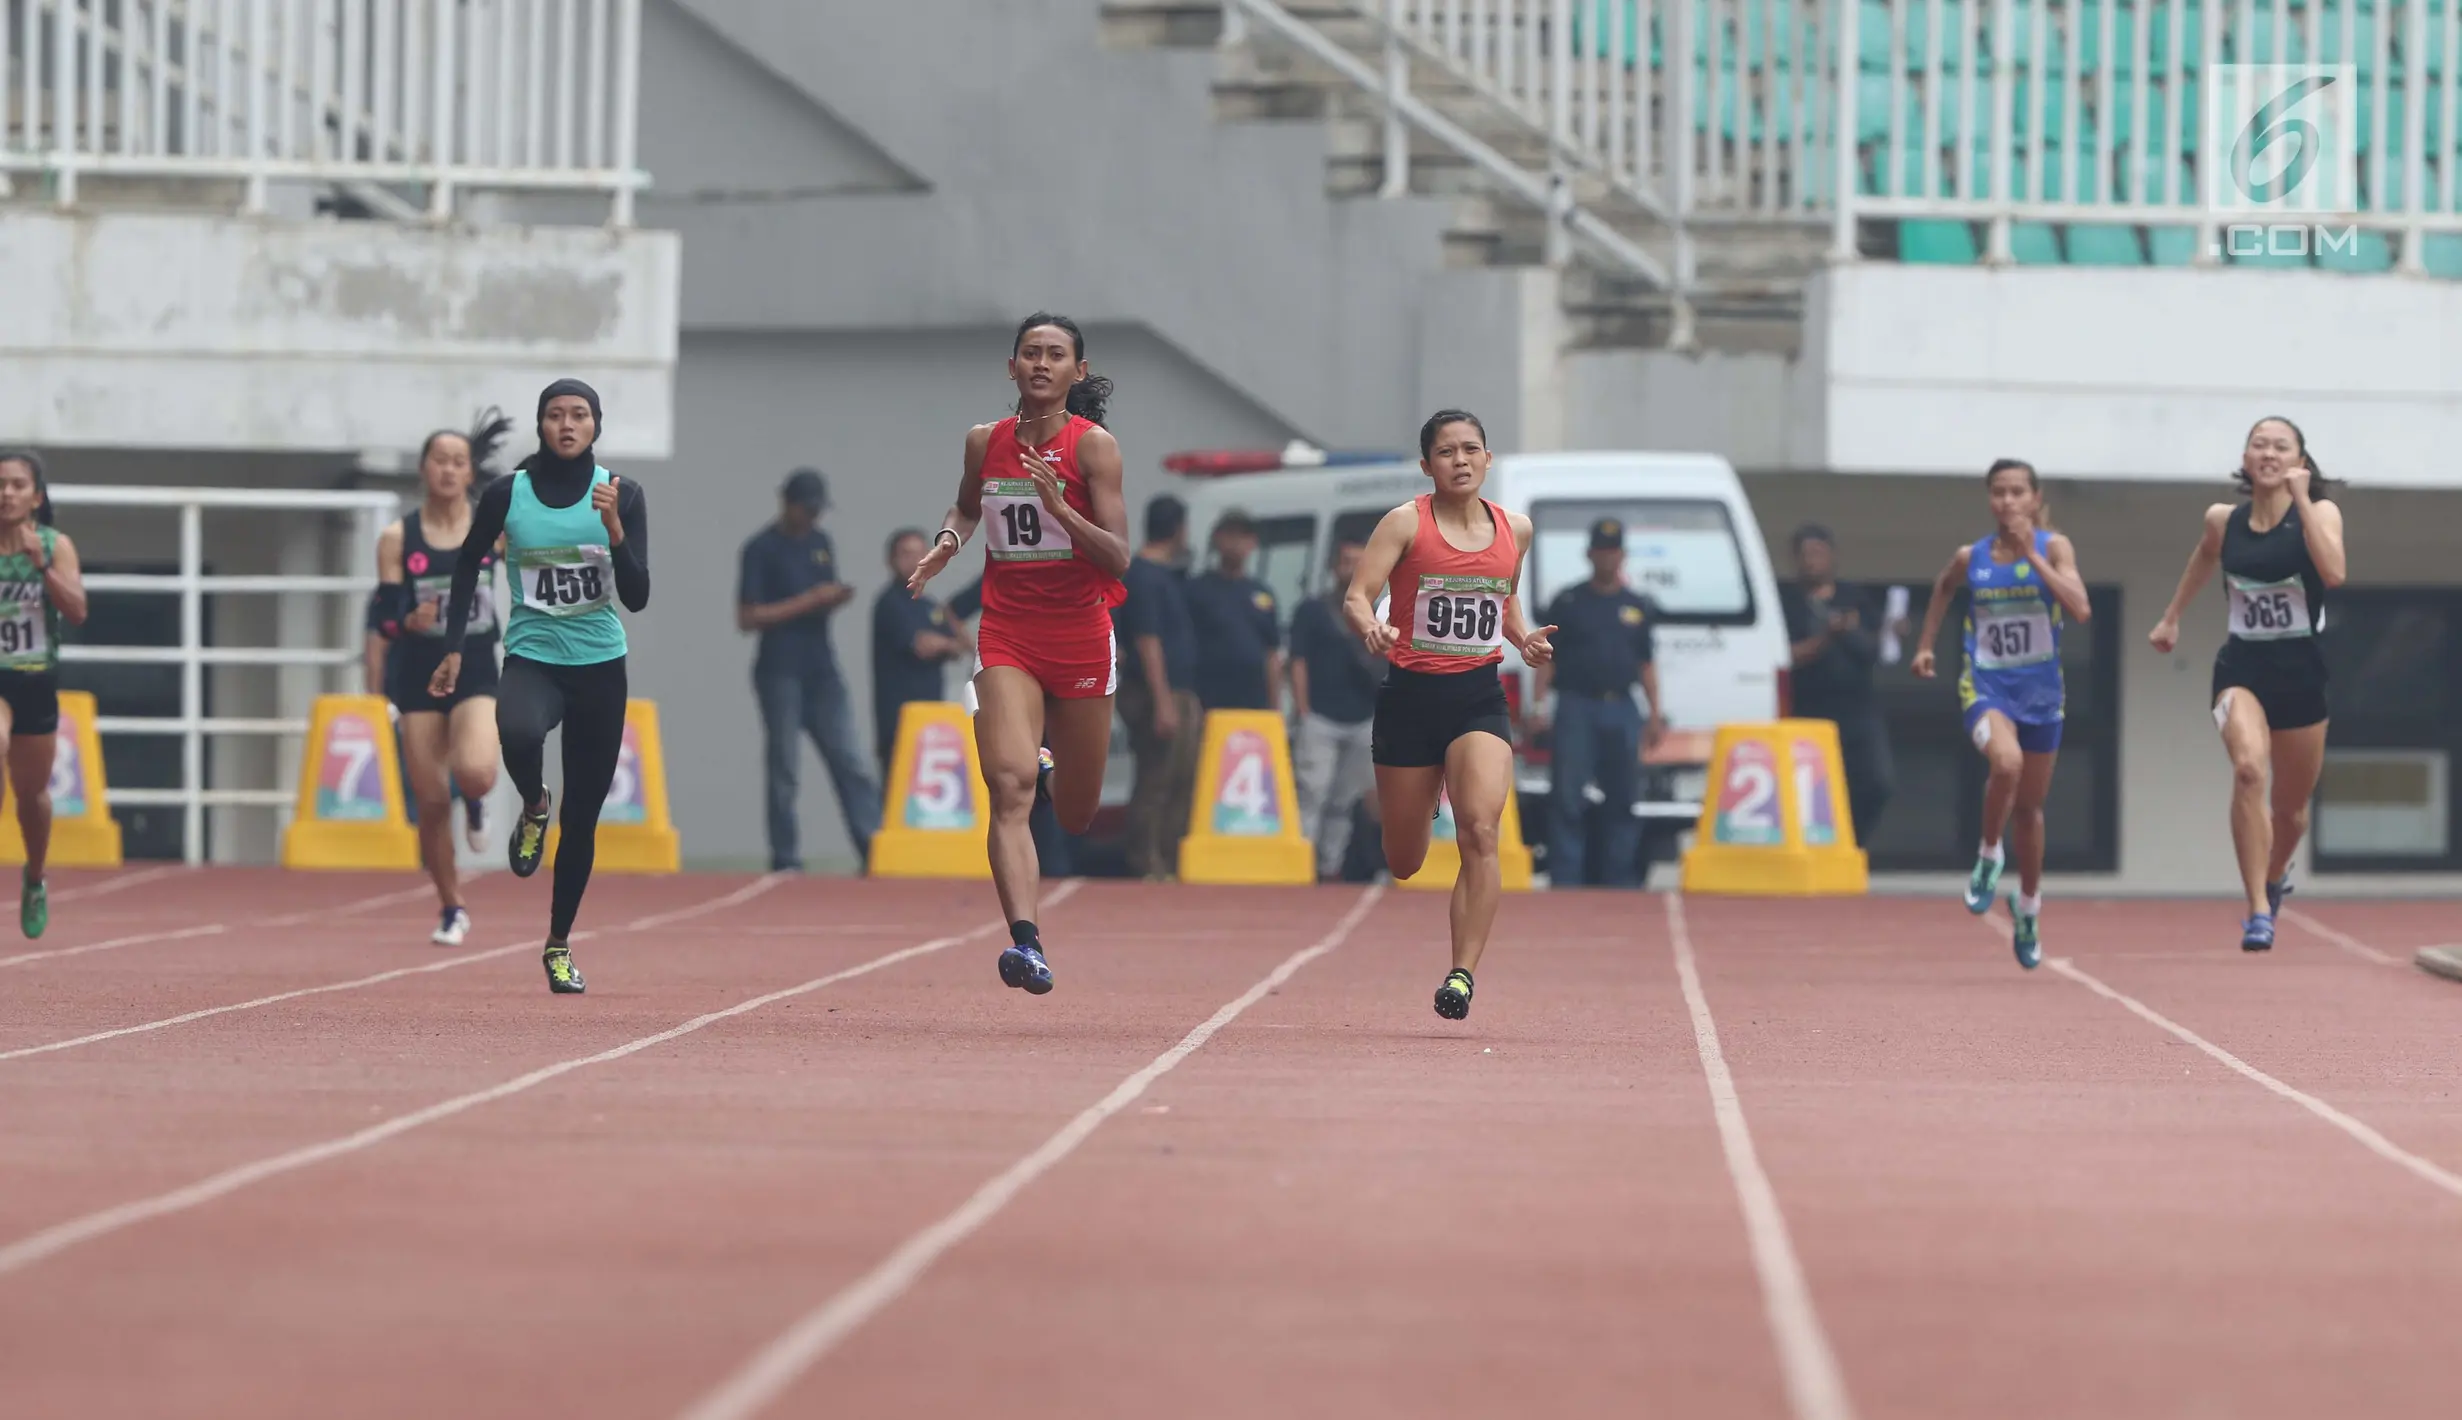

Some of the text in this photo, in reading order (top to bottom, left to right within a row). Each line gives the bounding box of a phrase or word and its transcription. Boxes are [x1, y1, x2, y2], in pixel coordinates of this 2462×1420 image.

[1000, 503, 1043, 546] 19
[535, 565, 603, 607] 458
[1426, 594, 1498, 641] 958
[2243, 592, 2294, 630] 365
[1987, 620, 2032, 658] 357
[328, 739, 375, 804] 7
[916, 748, 963, 813] 5
[1221, 753, 1269, 816] 4
[1727, 763, 1775, 829] 2
